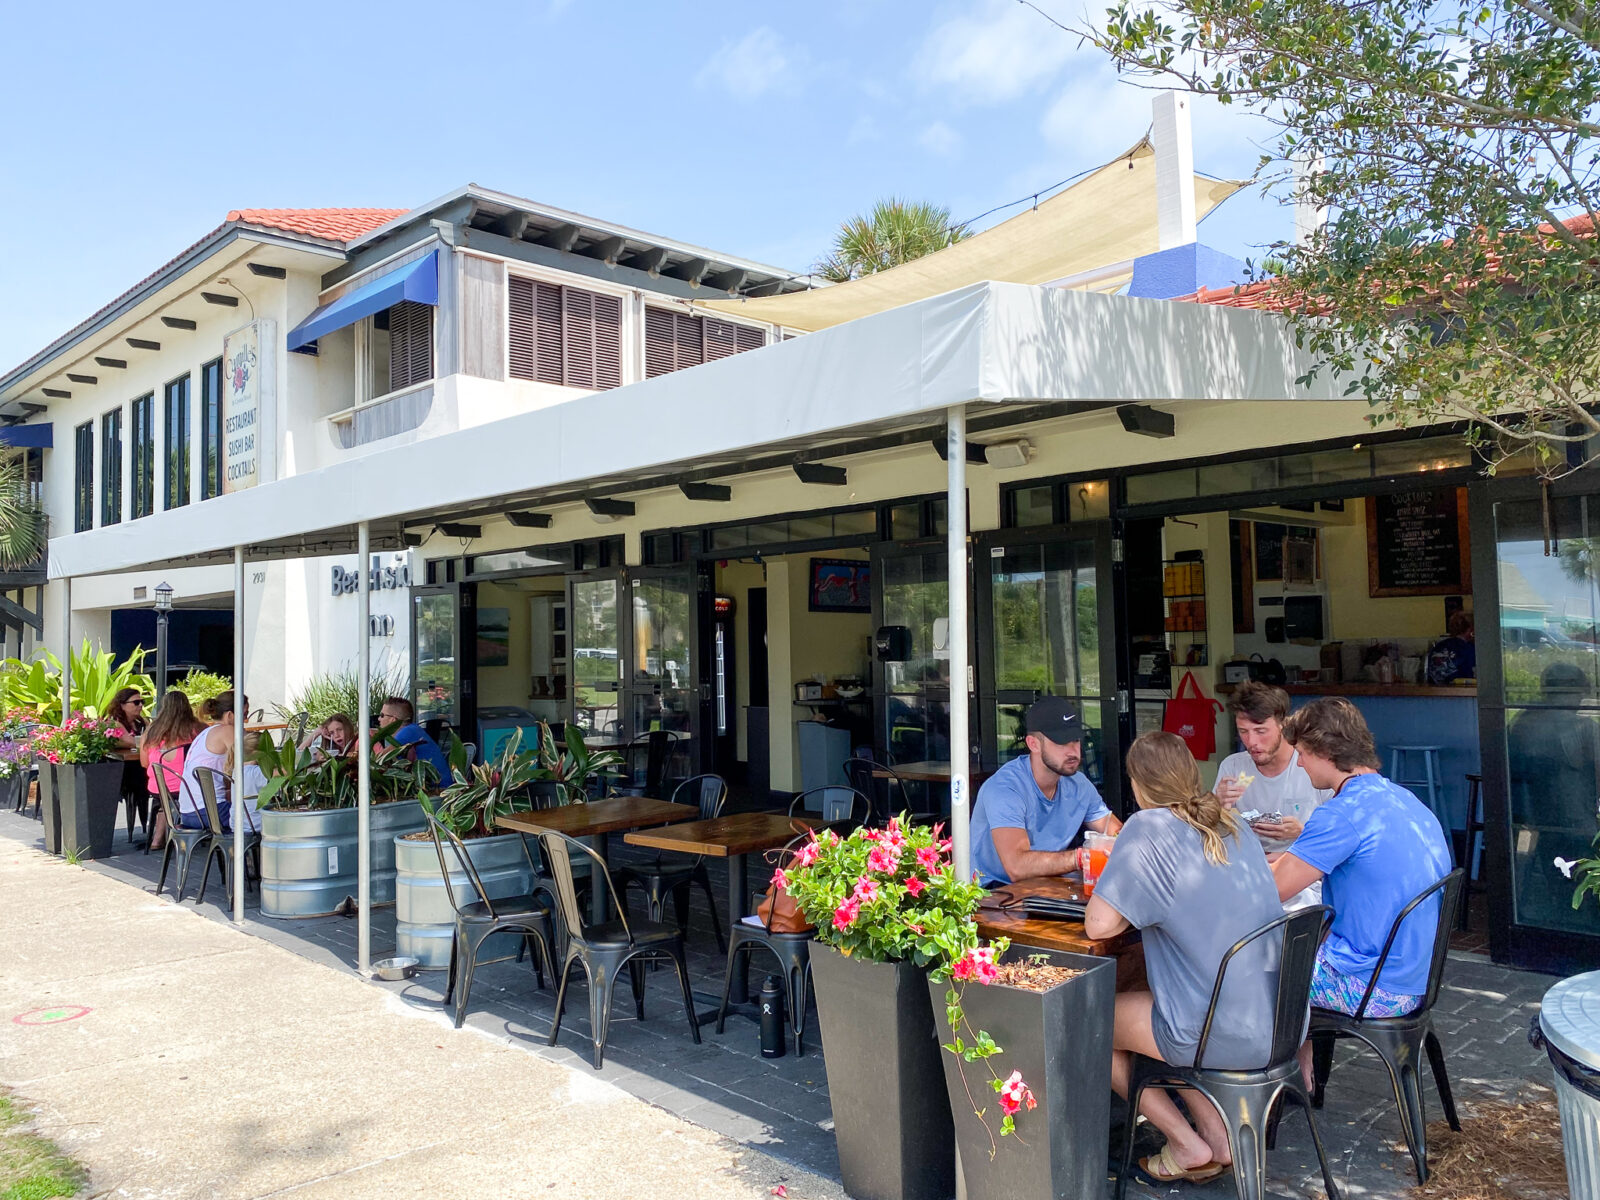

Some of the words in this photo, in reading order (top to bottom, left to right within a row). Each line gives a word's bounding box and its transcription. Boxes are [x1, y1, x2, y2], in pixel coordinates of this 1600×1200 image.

[226, 408, 257, 434] RESTAURANT
[228, 437, 243, 457] SUSHI
[244, 433, 255, 453] BAR
[227, 458, 256, 481] COCKTAILS
[331, 551, 413, 596] Beahsid
[369, 614, 394, 637] nn
